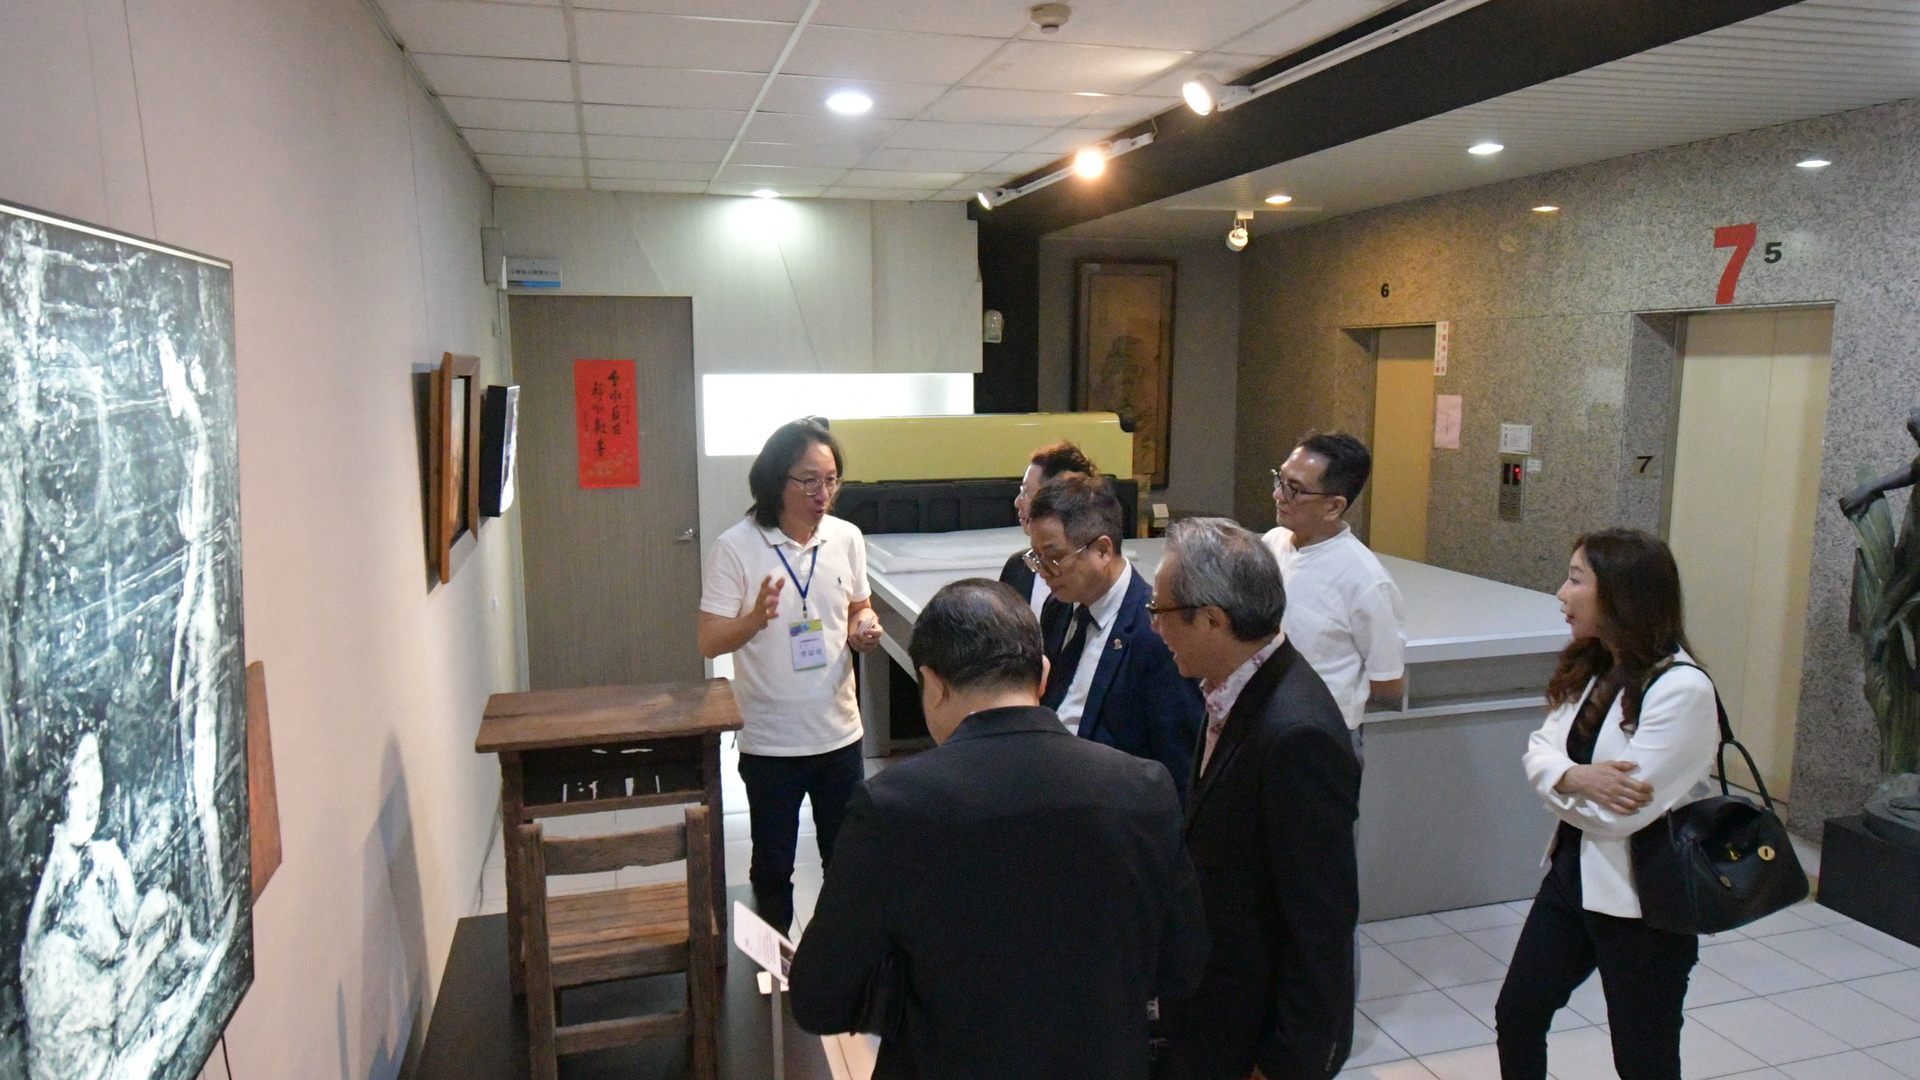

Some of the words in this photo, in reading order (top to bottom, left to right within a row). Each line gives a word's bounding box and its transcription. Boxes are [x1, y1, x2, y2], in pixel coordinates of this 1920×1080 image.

[1764, 242, 1782, 264] 5
[1714, 223, 1758, 304] 7
[1380, 283, 1390, 298] 6
[1637, 455, 1653, 473] 7
